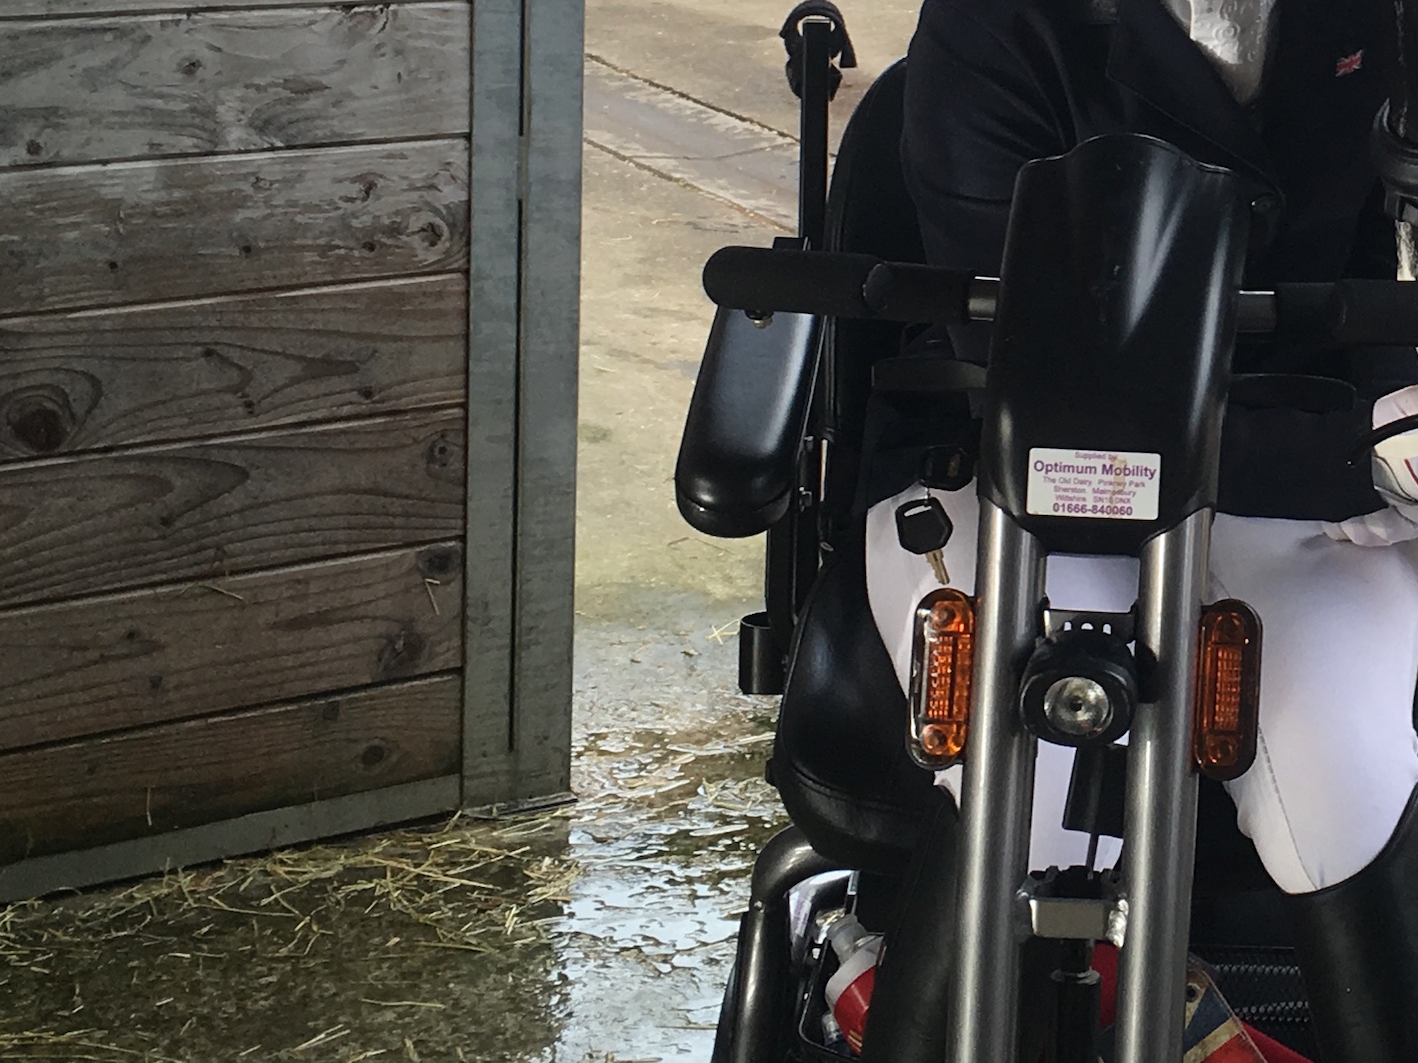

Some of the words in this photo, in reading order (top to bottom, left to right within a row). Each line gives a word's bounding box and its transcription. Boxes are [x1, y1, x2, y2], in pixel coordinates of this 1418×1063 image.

[1033, 459, 1098, 475] Optimum
[1101, 463, 1157, 480] Mobility
[1043, 476, 1057, 484] The
[1058, 476, 1072, 484] Old
[1128, 480, 1146, 488] Park
[1052, 502, 1133, 516] 01666-840060
